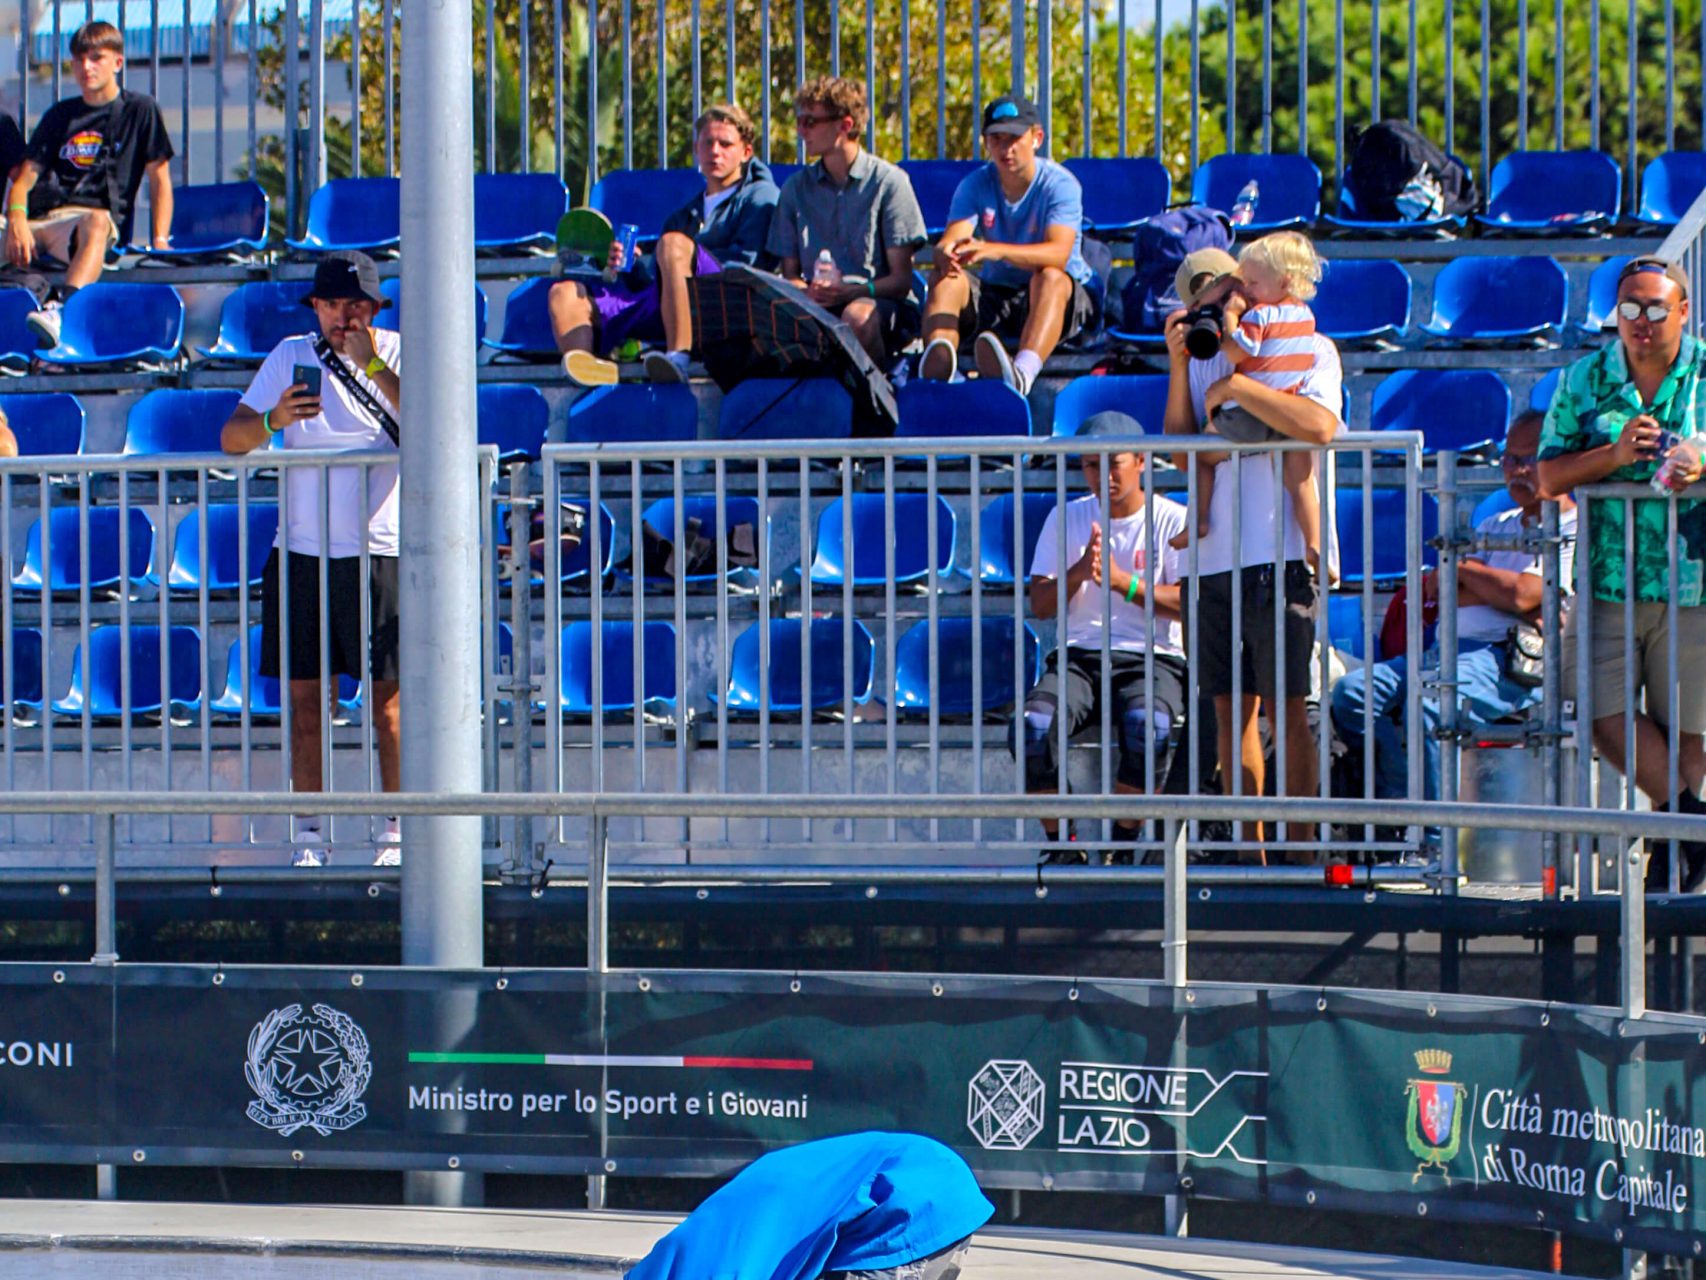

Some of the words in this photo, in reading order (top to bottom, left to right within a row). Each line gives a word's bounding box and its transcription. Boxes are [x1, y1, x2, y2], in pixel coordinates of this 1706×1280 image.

[408, 1086, 513, 1113] Ministro
[522, 1095, 567, 1118] per
[575, 1089, 596, 1113] lo
[604, 1090, 677, 1118] Sport
[685, 1097, 700, 1115] e
[707, 1091, 714, 1115] i
[721, 1091, 808, 1119] Giovani
[1059, 1069, 1188, 1106] REGIONE
[316, 1110, 364, 1127] ITALIANA
[1057, 1115, 1151, 1147] LAZIO
[1481, 1088, 1543, 1134] Città
[1550, 1106, 1706, 1158] metropolitana
[1483, 1144, 1508, 1183] di
[1509, 1147, 1586, 1197] Roma
[1595, 1159, 1688, 1216] Capitale
